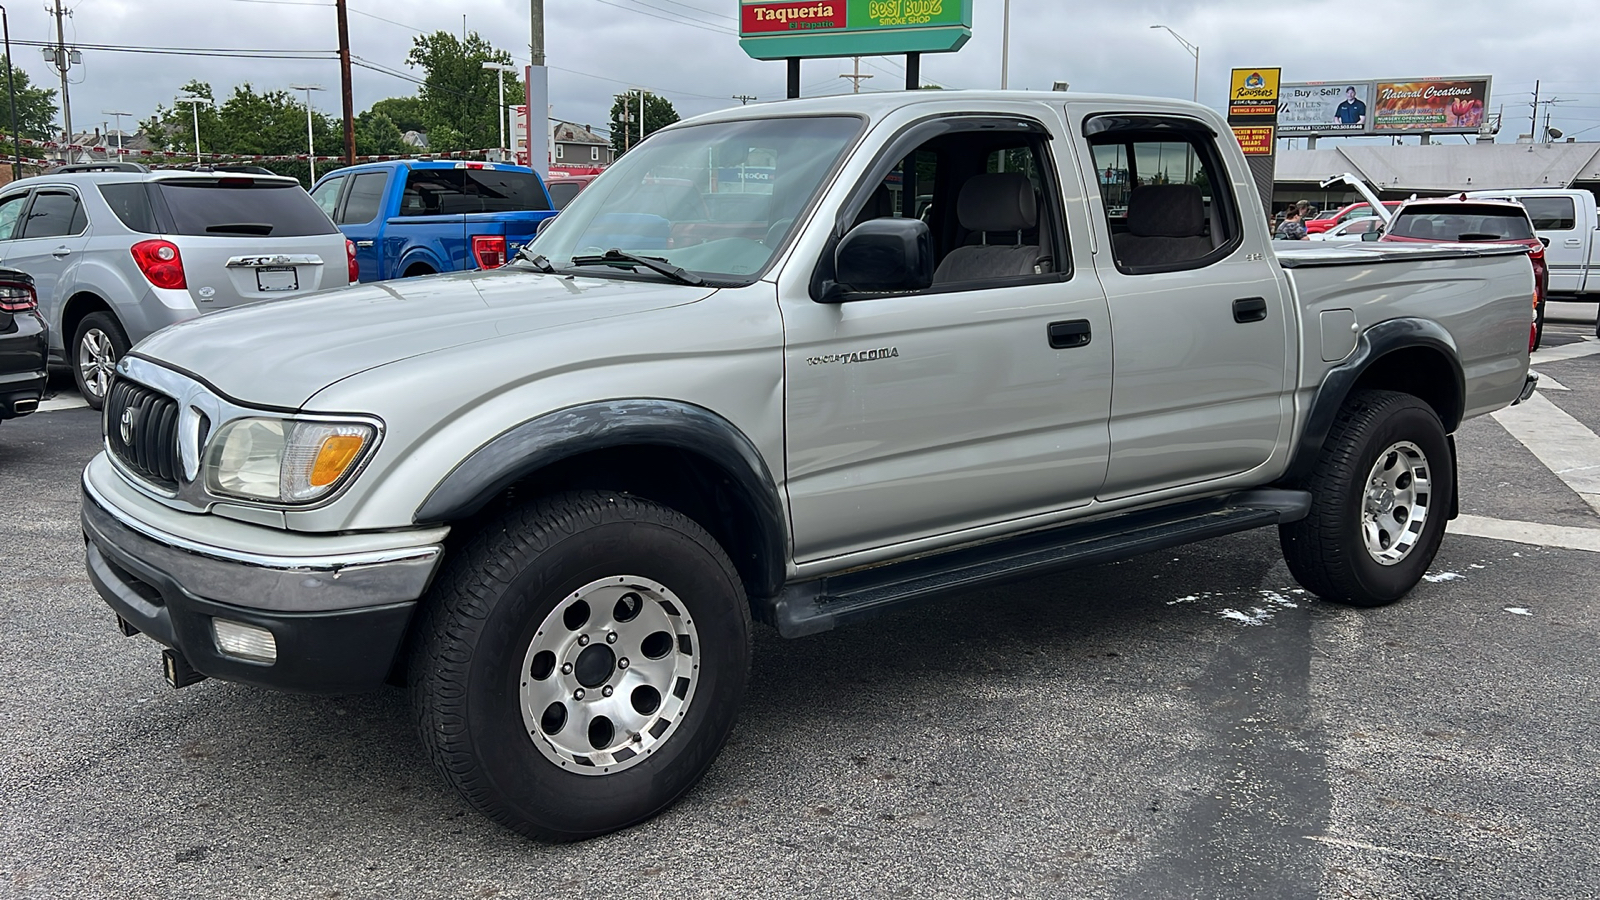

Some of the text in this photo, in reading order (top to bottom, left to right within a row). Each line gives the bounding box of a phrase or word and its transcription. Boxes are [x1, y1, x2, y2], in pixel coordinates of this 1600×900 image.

[879, 16, 931, 26] SMOKE SHOP
[1236, 87, 1273, 98] Roosters
[1294, 89, 1311, 99] Buy
[1320, 88, 1341, 97] Sell?
[1382, 86, 1472, 100] Natural Creations
[806, 347, 899, 366] TOYOTA TACOMA
